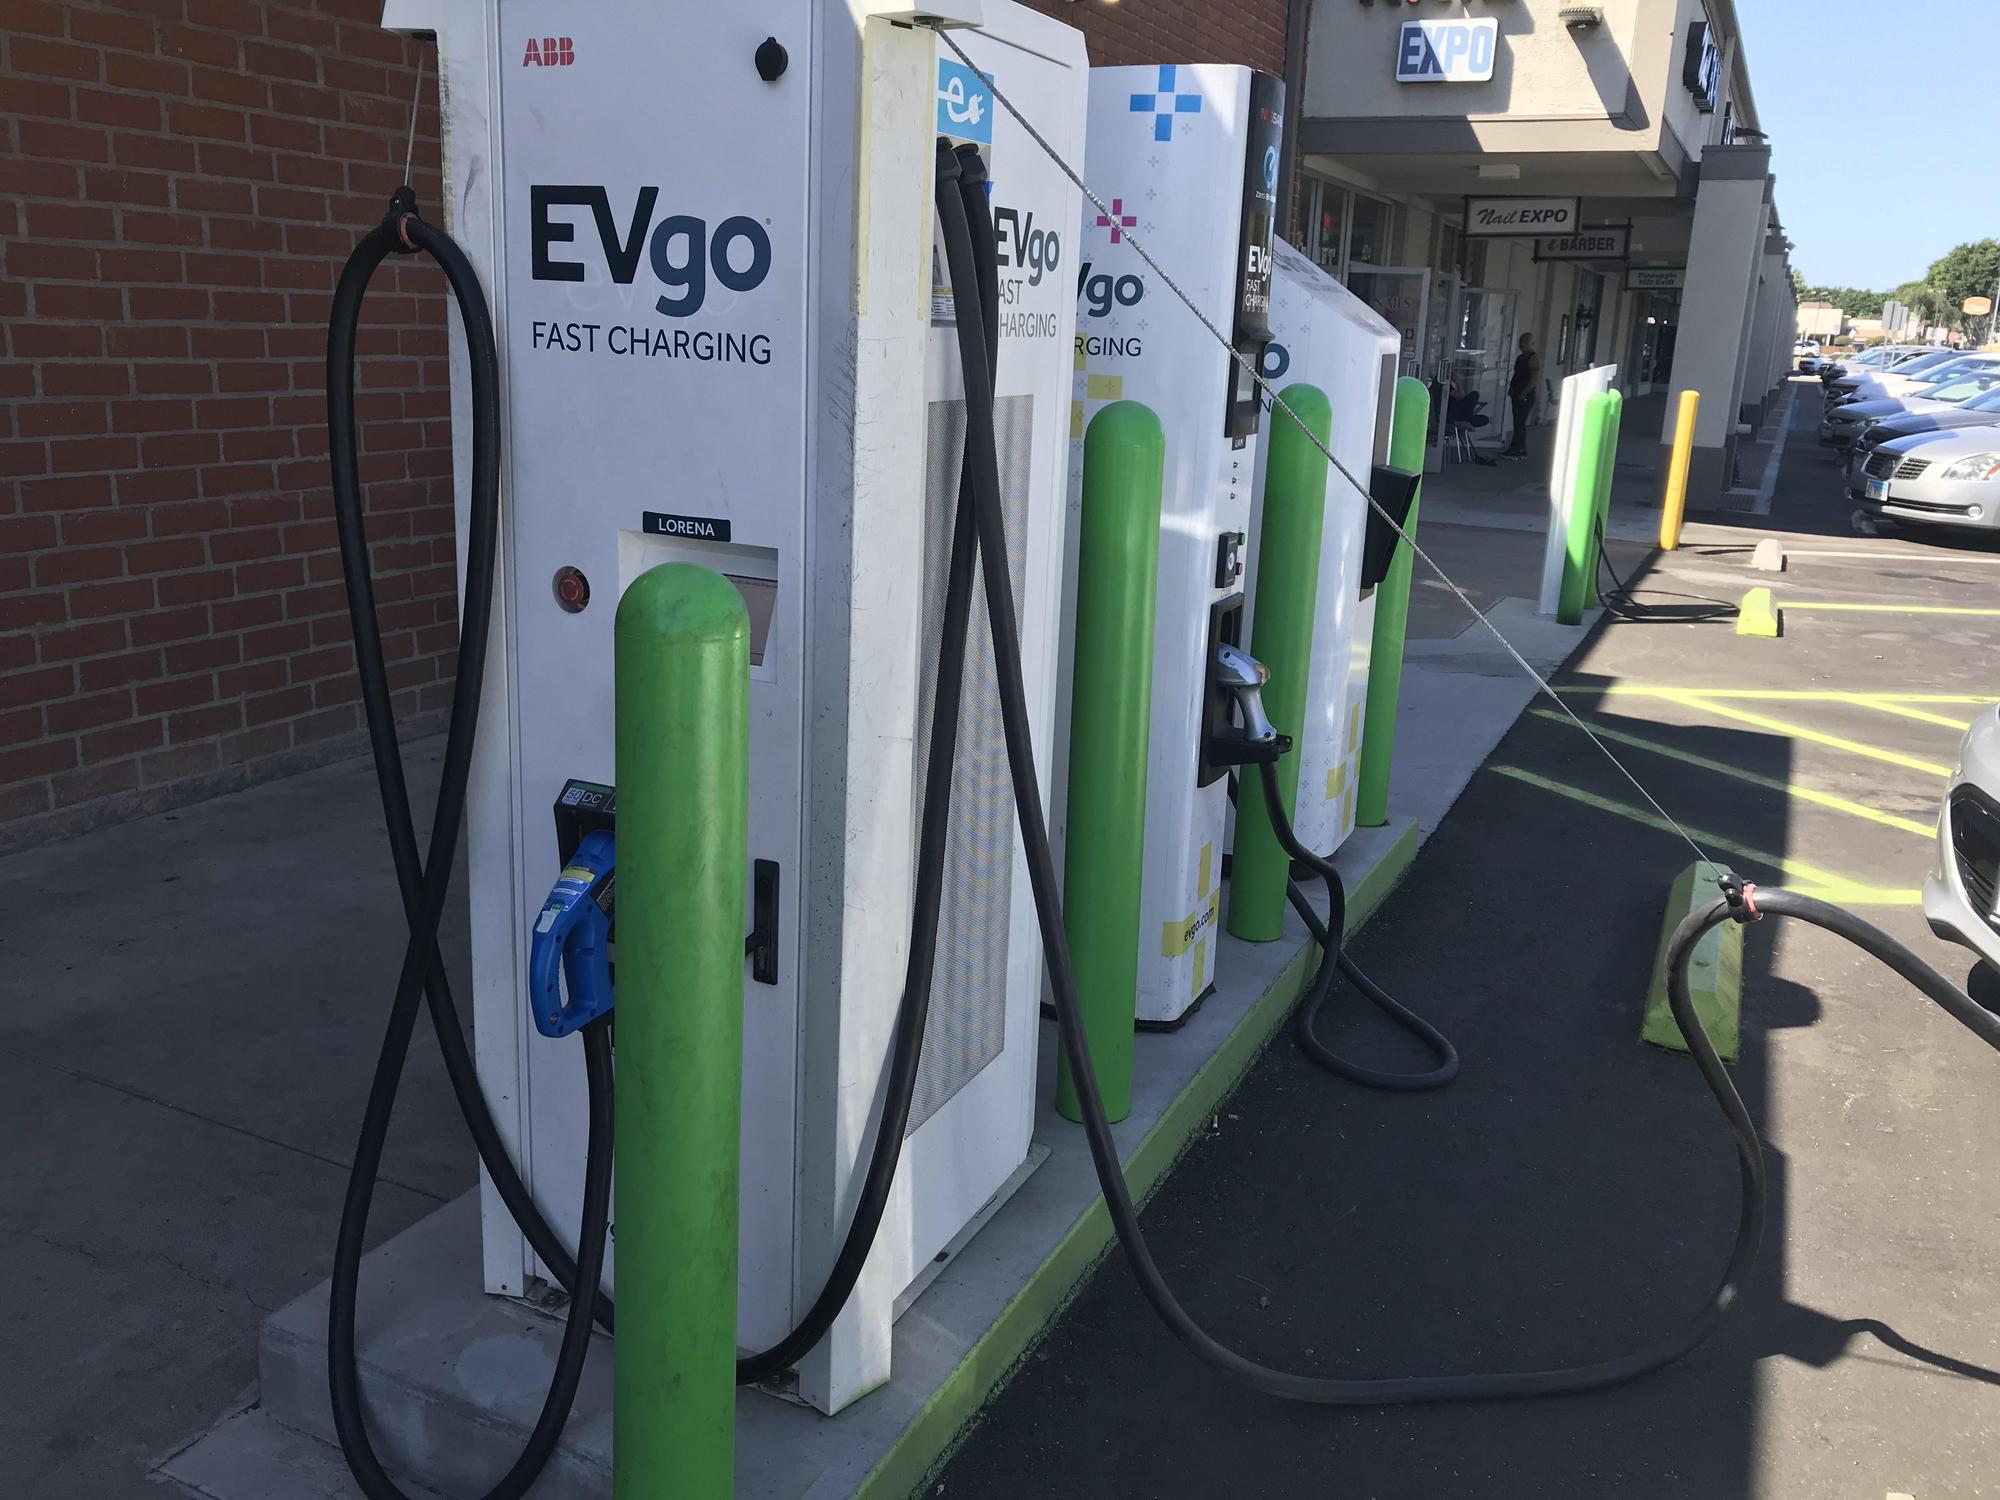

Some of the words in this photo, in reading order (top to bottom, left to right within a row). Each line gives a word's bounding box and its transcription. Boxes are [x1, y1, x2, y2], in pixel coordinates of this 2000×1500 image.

[523, 37, 575, 67] ABB
[1399, 25, 1494, 75] EXPO
[1476, 208, 1518, 225] Nail
[1519, 208, 1569, 223] EXPO
[530, 184, 772, 318] EVgo
[995, 206, 1060, 287] EVgo
[1559, 236, 1615, 251] BARBER
[998, 279, 1023, 305] AST
[1077, 262, 1144, 318] go
[1246, 278, 1261, 292] FAST
[999, 313, 1057, 338] HARGING
[532, 321, 601, 353] FAST
[607, 325, 772, 365] CHARGING
[1074, 336, 1142, 357] RGING
[658, 518, 715, 537] LORENA
[566, 789, 582, 801] 50
[582, 792, 602, 804] DC
[1184, 906, 1214, 942] evgo.com
